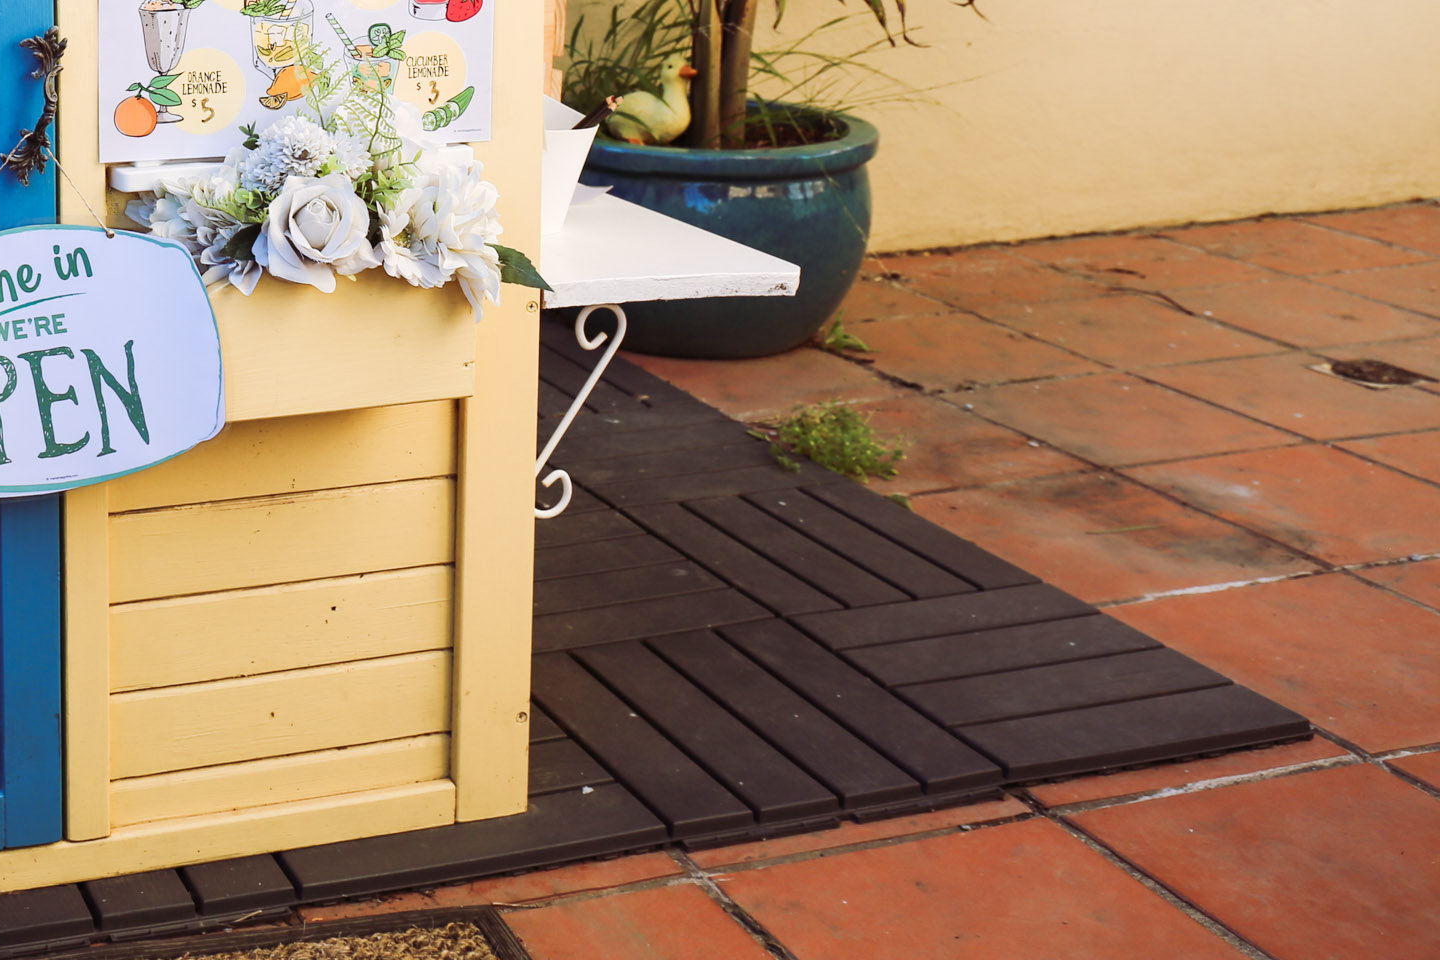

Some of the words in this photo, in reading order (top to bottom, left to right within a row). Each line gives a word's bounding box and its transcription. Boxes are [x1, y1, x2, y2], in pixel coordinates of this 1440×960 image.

[406, 54, 449, 67] CUCUMBER
[187, 70, 222, 83] ORANGE
[408, 65, 449, 79] LEMONADE
[182, 82, 228, 96] LEMONADE
[53, 244, 94, 281] in
